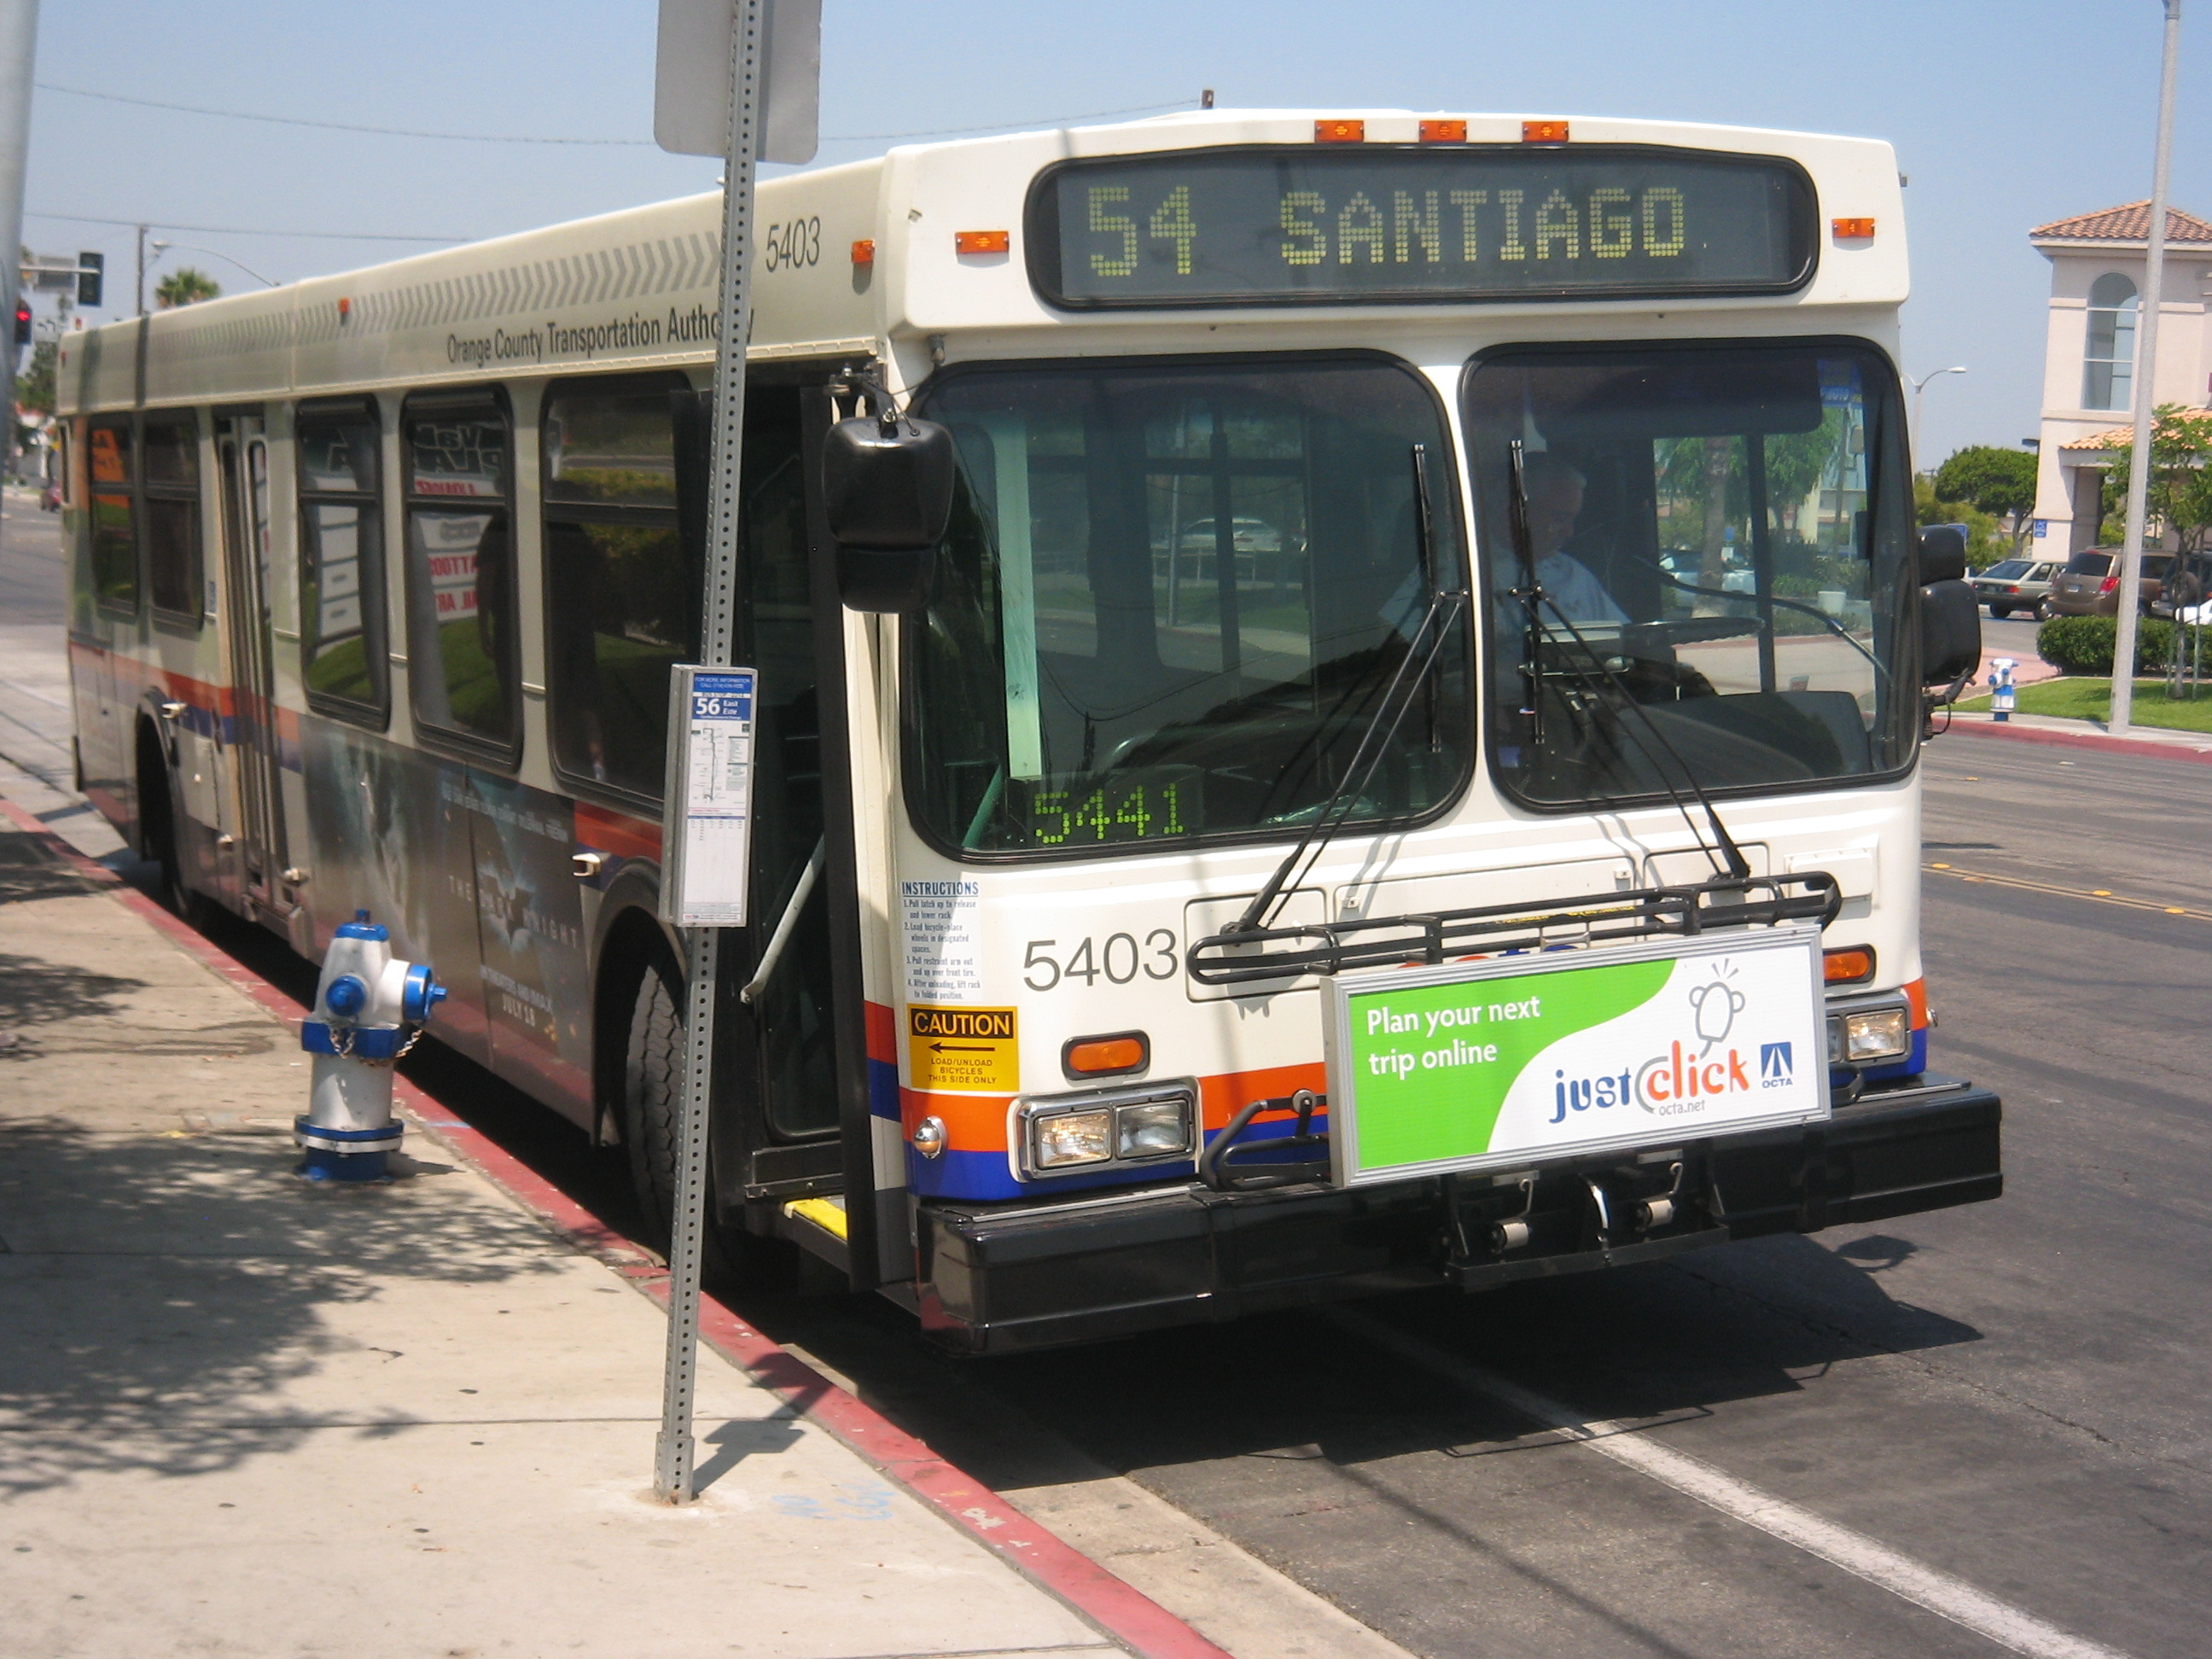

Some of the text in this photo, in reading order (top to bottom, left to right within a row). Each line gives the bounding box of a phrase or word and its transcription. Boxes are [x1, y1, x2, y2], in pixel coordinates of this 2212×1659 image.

[1088, 186, 1685, 276] 54 SANTIAGO
[765, 216, 822, 273] 5403
[446, 303, 754, 368] Orange County Transportation Authoy
[696, 697, 721, 715] 56
[1034, 783, 1184, 844] 5441
[902, 882, 979, 895] INSTRUCTIONS
[937, 901, 944, 910] up
[954, 899, 976, 908] release
[910, 911, 919, 919] and
[938, 934, 969, 944] designated
[923, 957, 948, 965] restraint
[1023, 928, 1179, 992] 5403
[946, 968, 961, 976] front
[957, 980, 966, 988] lift
[968, 980, 981, 988] rack
[914, 1012, 1010, 1036] CAUTION
[1367, 995, 1541, 1039] Plan your next
[931, 1057, 993, 1067] LOAD/UNLOAD
[1368, 1039, 1498, 1081] trip online
[928, 1074, 946, 1083] THIS
[940, 1067, 983, 1075] BICYCLES
[1548, 1039, 1749, 1124] just click
[1761, 1078, 1794, 1089] OCTA
[1658, 1099, 1706, 1116] octa.net
